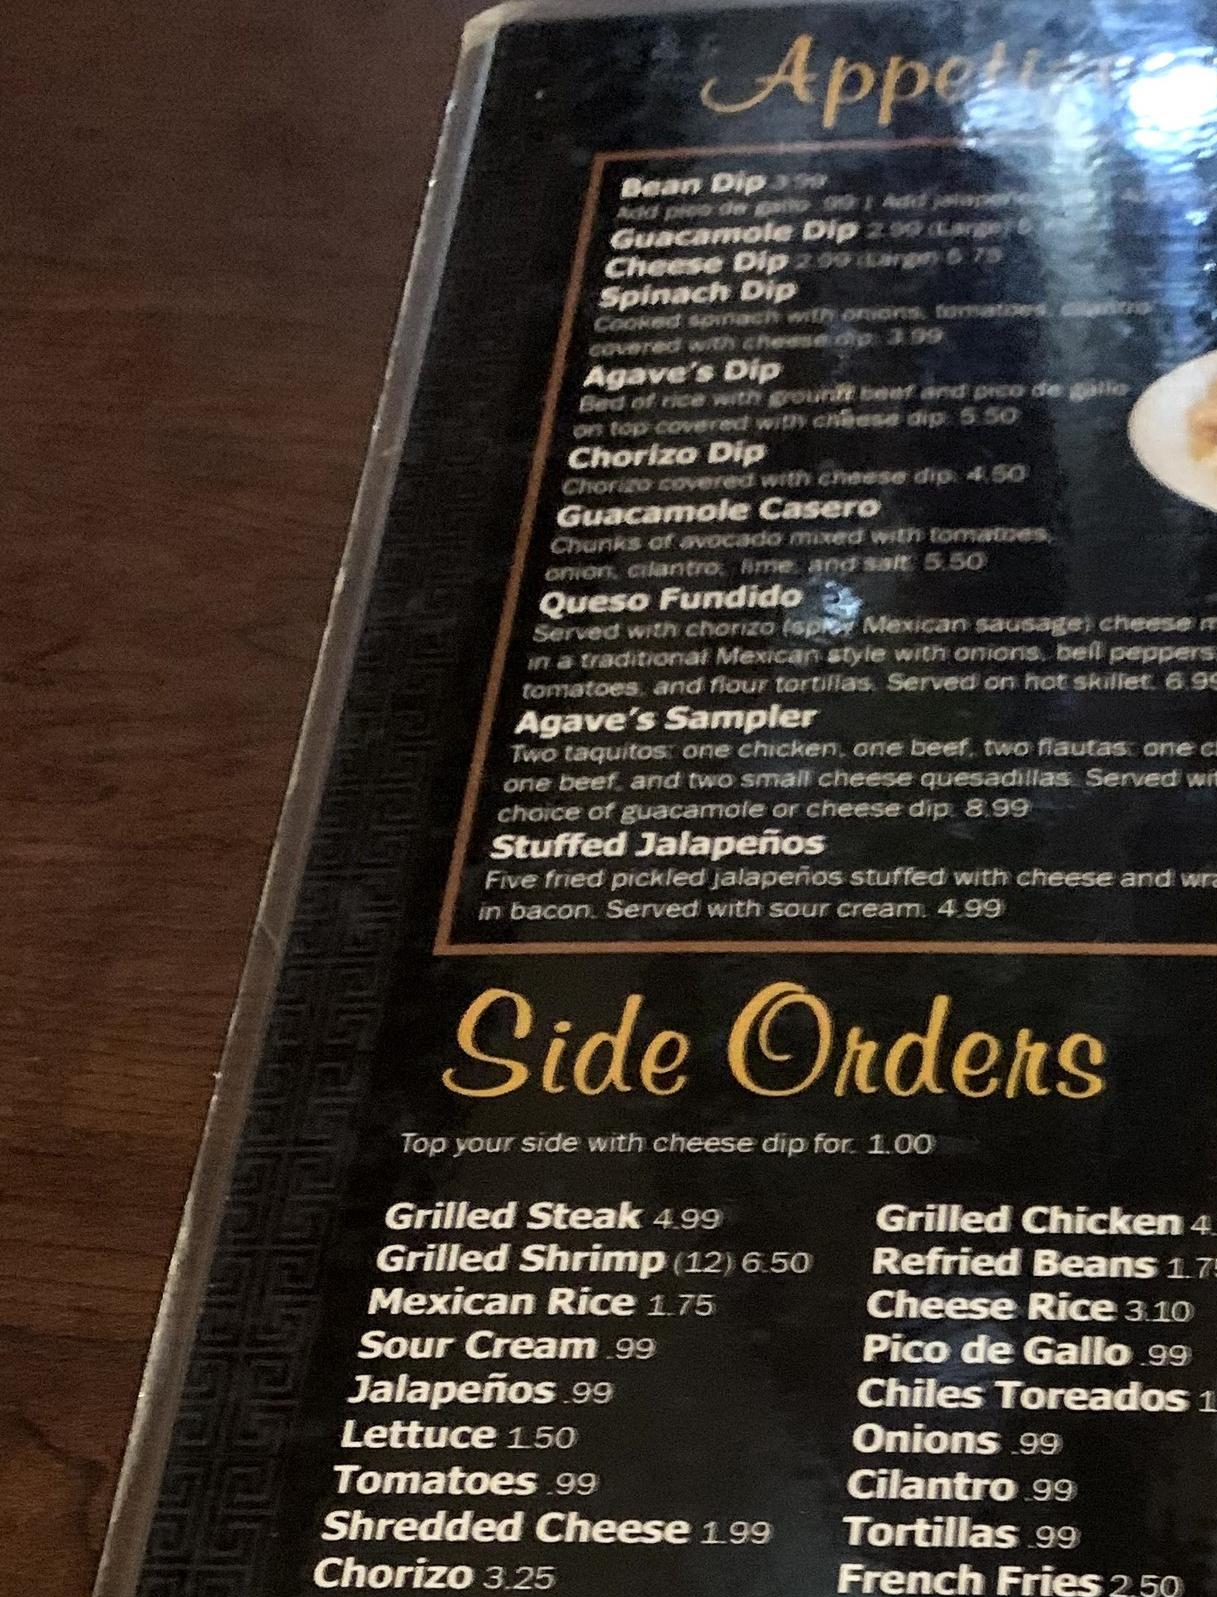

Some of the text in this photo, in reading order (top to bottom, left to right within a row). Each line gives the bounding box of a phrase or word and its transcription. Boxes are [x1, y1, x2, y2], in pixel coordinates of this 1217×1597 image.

[621, 171, 766, 198] Bean Dip
[605, 250, 789, 279] Cheese Dip
[583, 359, 781, 391] Agave's Dip
[568, 440, 765, 469] Chorizo Dip
[557, 497, 881, 528] Guacamole Casero
[540, 584, 803, 619] Queso Fundido
[514, 704, 818, 738] Agave's Sampler
[490, 829, 825, 861] Stuffed Jalapeños
[486, 870, 538, 890] Five
[545, 870, 605, 888] fried
[611, 868, 705, 891] pickled
[710, 866, 844, 890] jalapeños
[850, 867, 946, 886] stuffed
[954, 868, 1008, 886] with
[1017, 868, 1113, 887] cheese
[1120, 869, 1175, 887] and
[479, 906, 501, 920] in
[607, 899, 699, 919] Served
[708, 899, 761, 917] with
[769, 902, 830, 917] sour
[938, 898, 1004, 918] 4.99
[442, 981, 1105, 1098] Side Orders
[401, 1133, 447, 1157] Top
[453, 1137, 515, 1157] your
[521, 1133, 578, 1153] side
[589, 1133, 643, 1152] with
[653, 1133, 754, 1152] cheese
[762, 1133, 805, 1157] dip
[868, 1134, 935, 1154] 1.00
[385, 1201, 720, 1230] Grilled Steak 4.99
[877, 1204, 1011, 1233] Grilled
[1022, 1206, 1183, 1236] Chicken
[377, 1243, 809, 1279] Grilled Shrimp (12) 6.50
[867, 1290, 1190, 1322] Cheese Rice 3.10
[347, 1373, 556, 1410] Jalapeños
[858, 1378, 983, 1409] Chiles
[994, 1380, 1189, 1412] Toreados
[321, 1510, 770, 1544] Shredded Cheese 1.99
[838, 1563, 1179, 1597] French Fries 2.50
